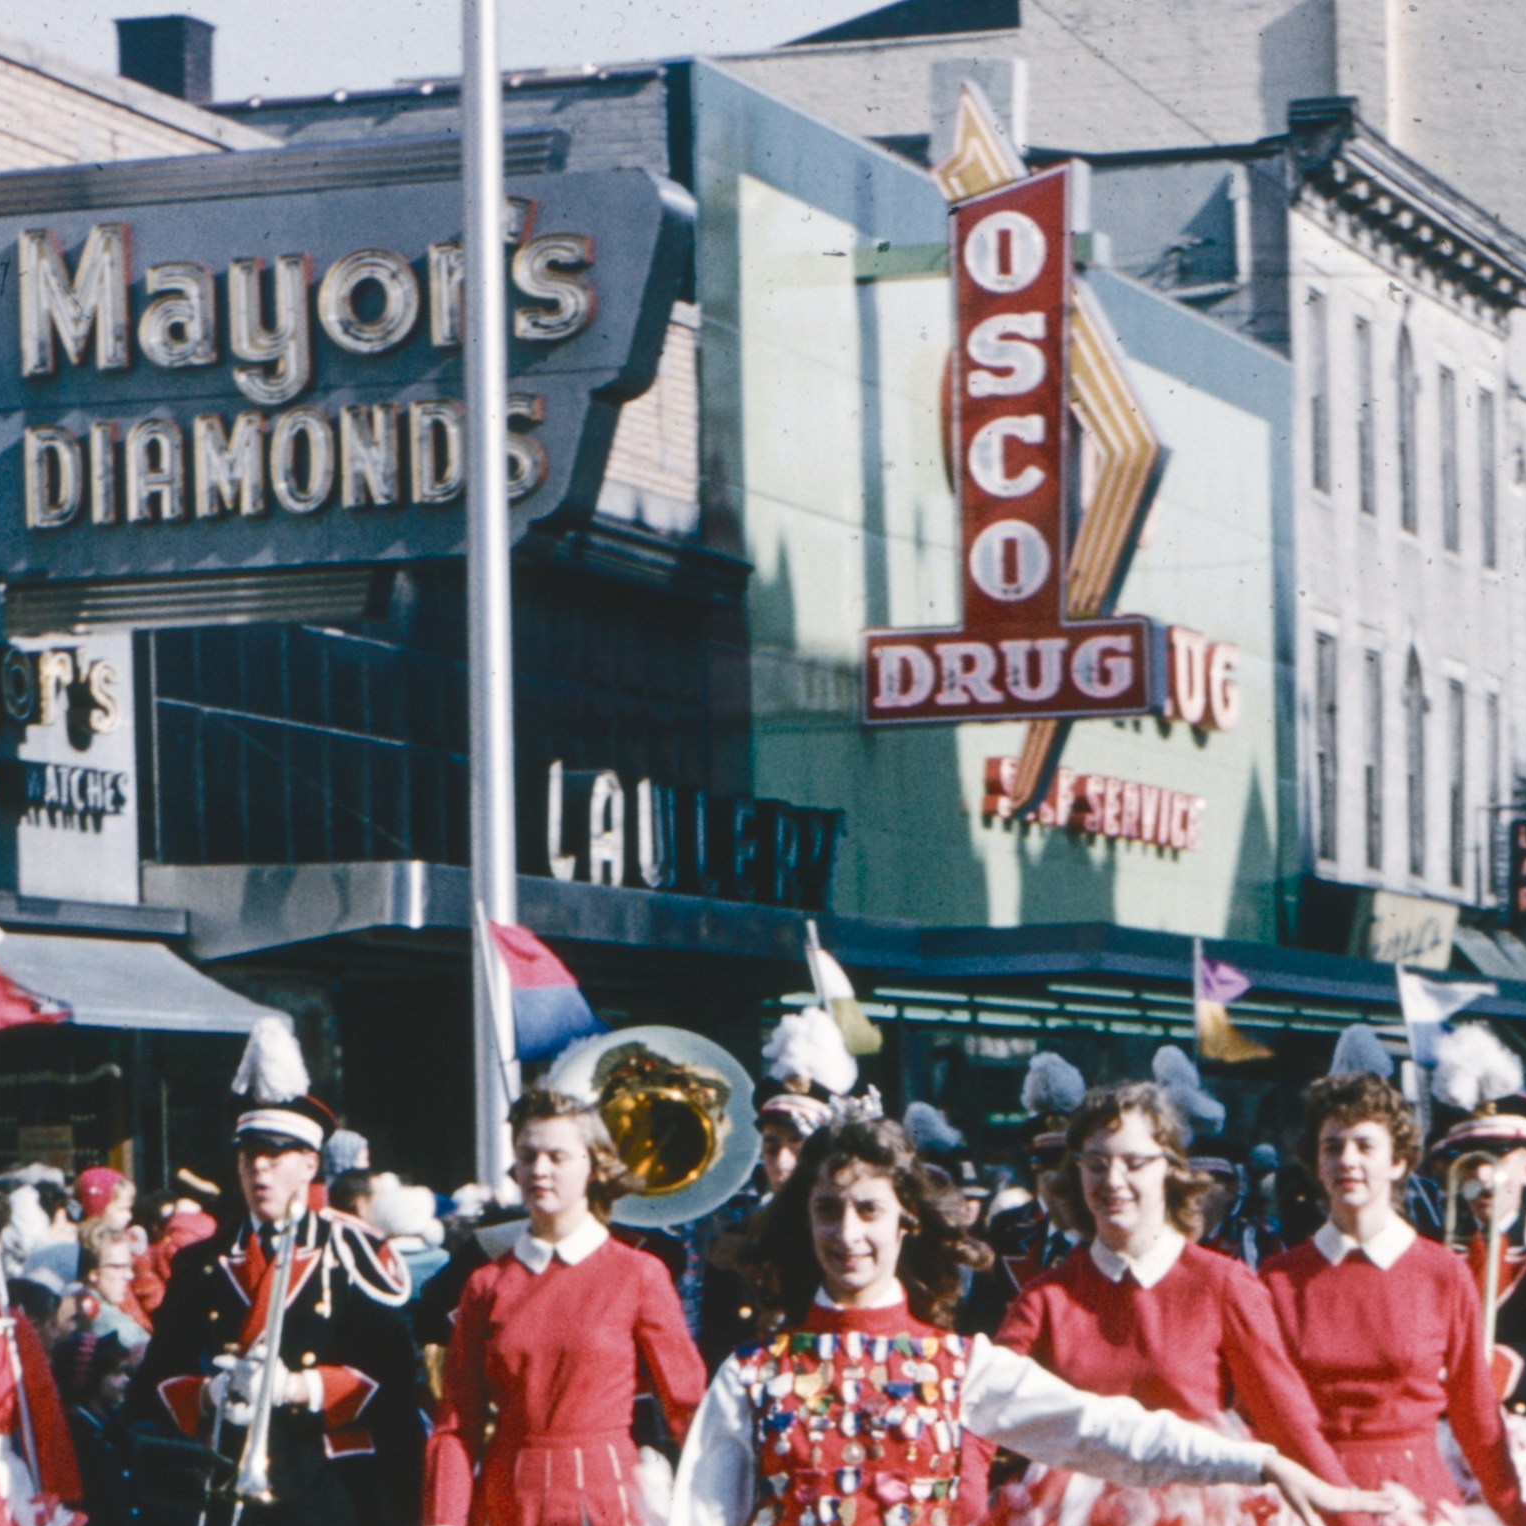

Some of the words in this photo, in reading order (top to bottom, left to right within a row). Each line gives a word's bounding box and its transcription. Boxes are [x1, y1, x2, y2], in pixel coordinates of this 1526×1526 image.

[16, 198, 597, 404] Mayor's
[23, 393, 549, 531] DIAMONDS
[964, 209, 1050, 603] OSCO
[873, 632, 1136, 712] DRUG
[1084, 773, 1206, 850] SERVICE
